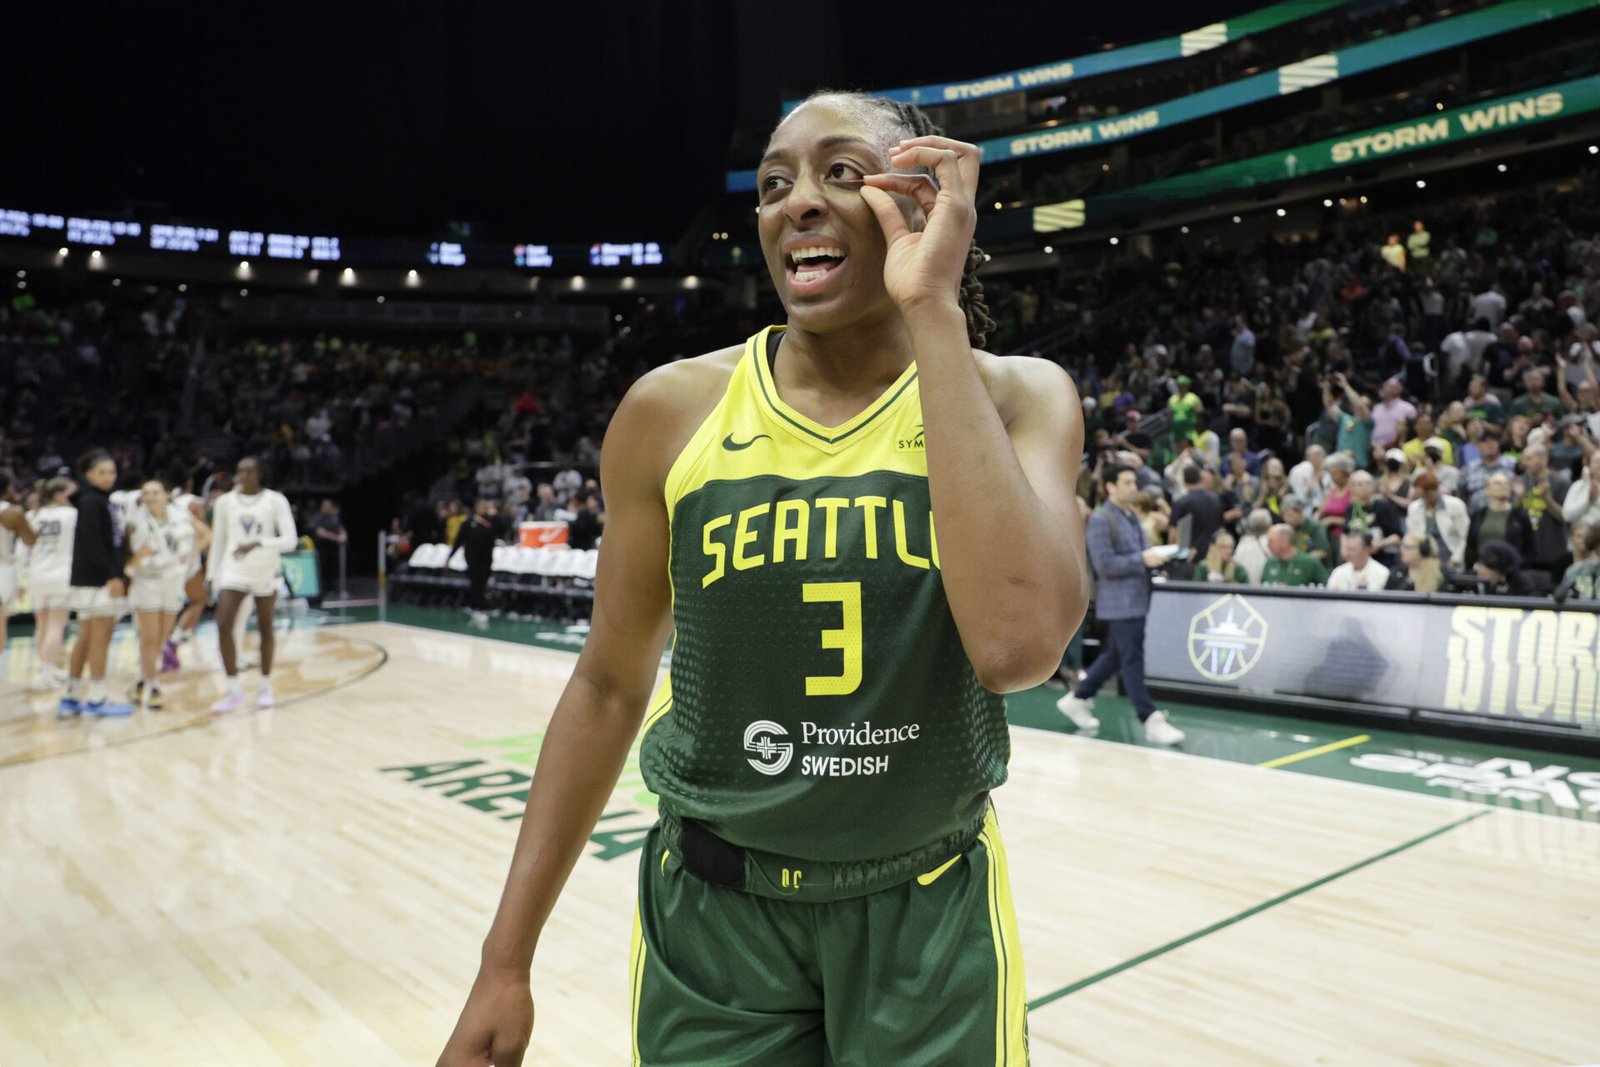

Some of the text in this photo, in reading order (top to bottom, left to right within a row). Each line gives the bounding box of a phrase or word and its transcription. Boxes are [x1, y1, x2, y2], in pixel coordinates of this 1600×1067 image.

[943, 63, 1074, 101] STORM WINS
[1010, 110, 1159, 155] STORM WINS
[1330, 92, 1564, 163] STORM WINS
[702, 495, 941, 589] SEATTL
[802, 581, 863, 696] 3
[1444, 605, 1600, 727] STOR
[801, 721, 920, 748] Providence
[801, 755, 889, 777] SWEDISH
[379, 757, 652, 861] AREA
